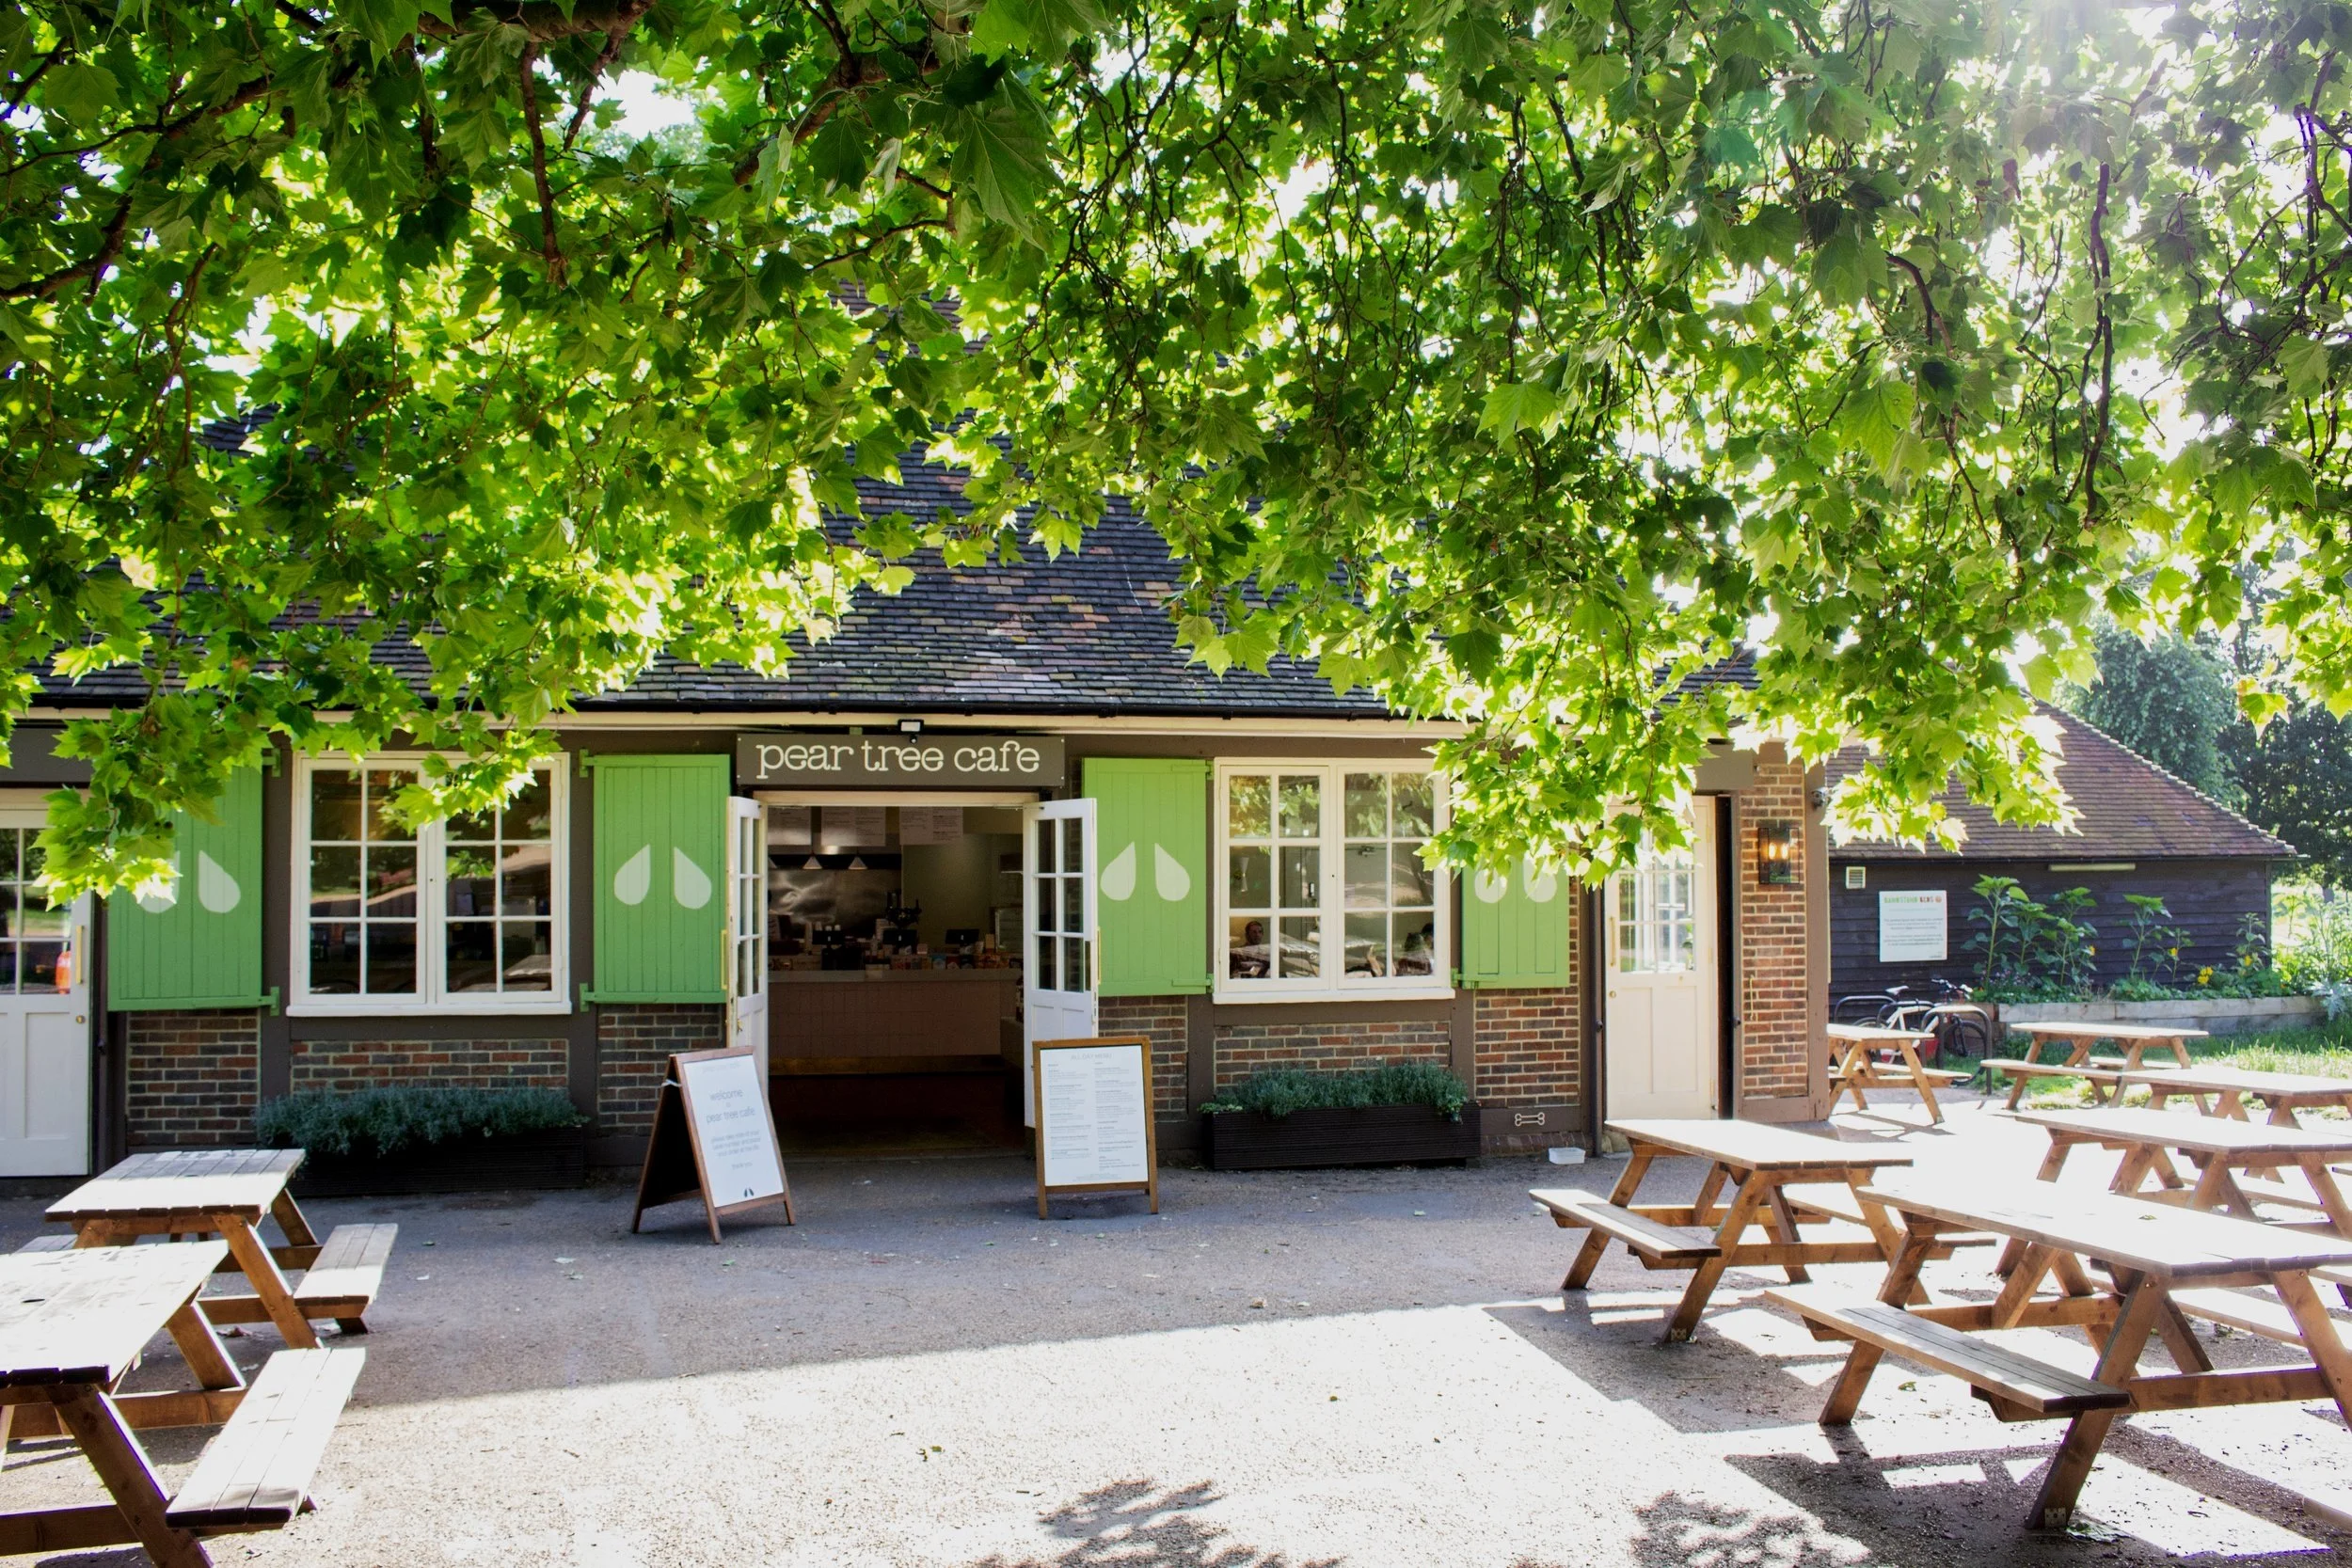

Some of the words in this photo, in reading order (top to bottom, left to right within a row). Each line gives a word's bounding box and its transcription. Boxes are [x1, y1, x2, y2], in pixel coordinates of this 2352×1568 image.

[755, 743, 854, 780] pear
[861, 740, 945, 772] tree
[954, 740, 1041, 773] cafe
[709, 1089, 744, 1101] welcome
[707, 1113, 723, 1125] pear
[723, 1111, 739, 1120] tree
[739, 1106, 756, 1118] cafe
